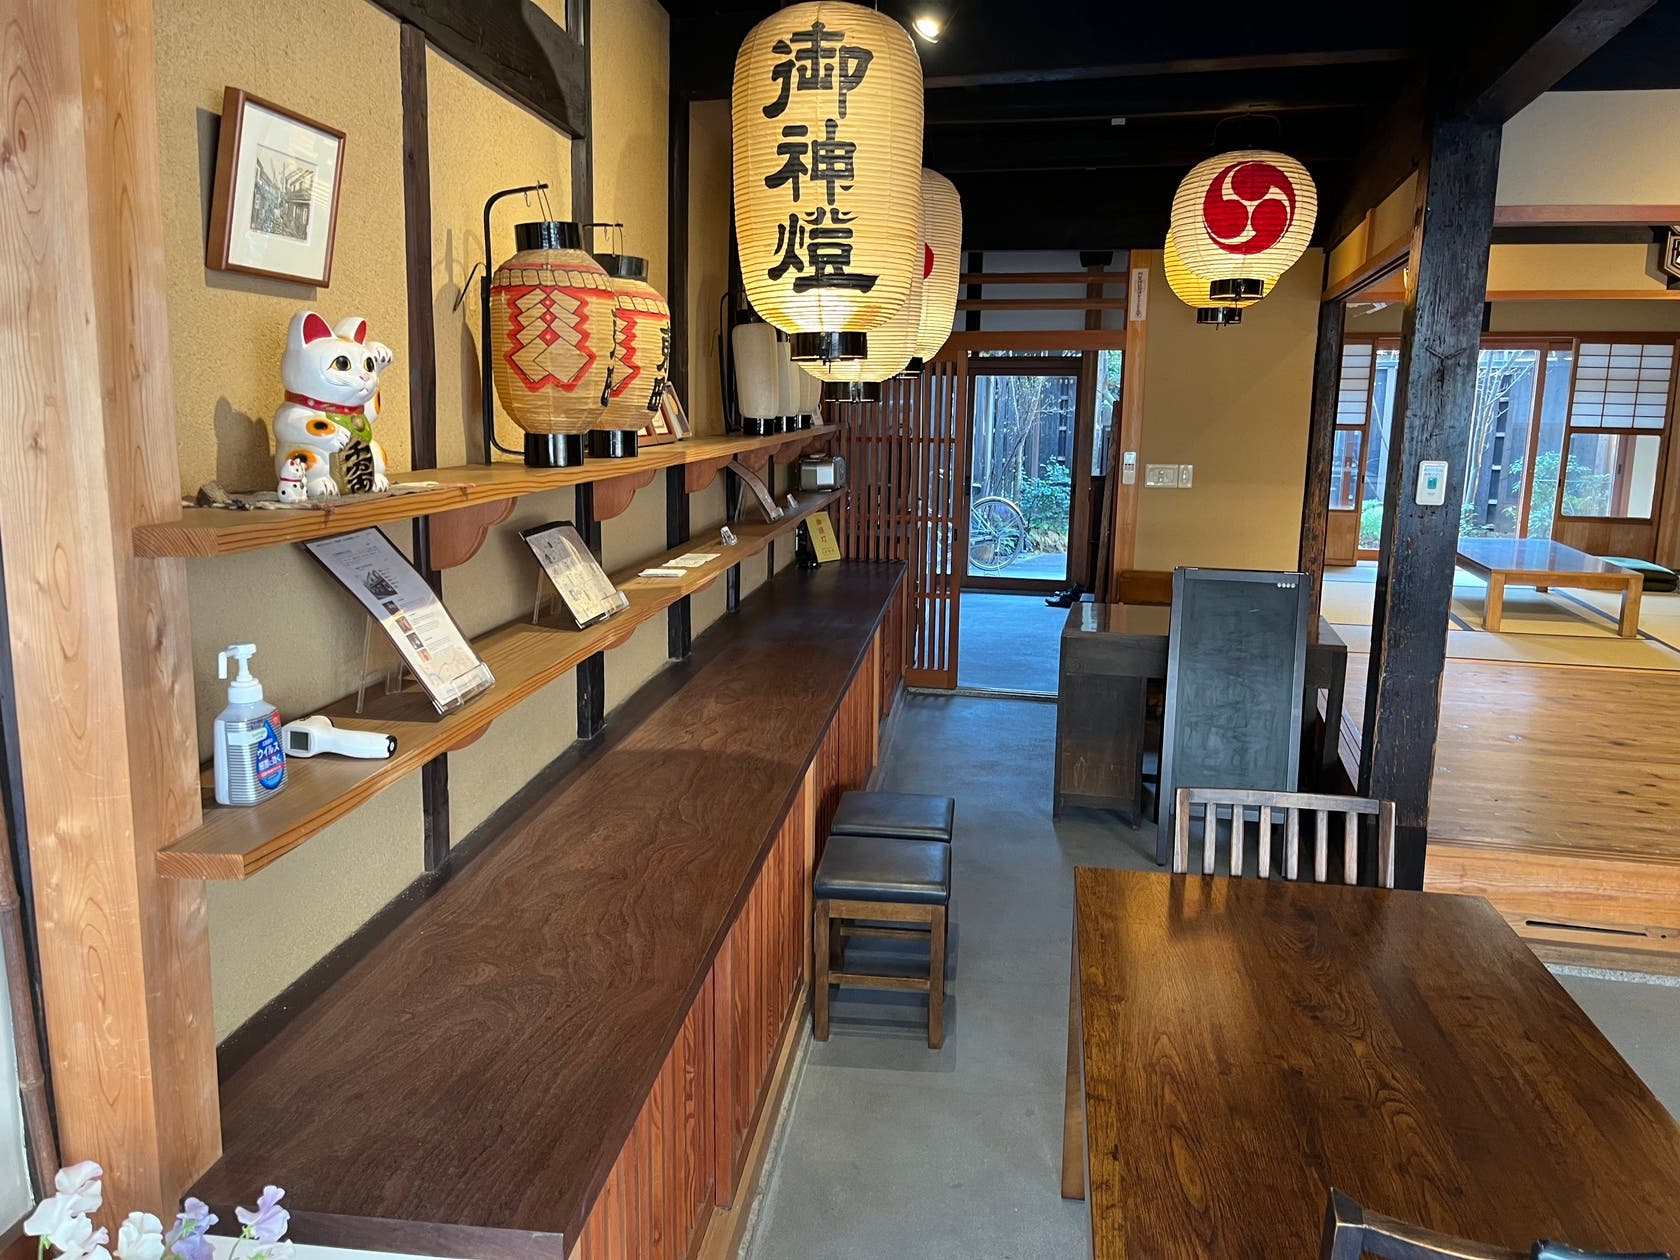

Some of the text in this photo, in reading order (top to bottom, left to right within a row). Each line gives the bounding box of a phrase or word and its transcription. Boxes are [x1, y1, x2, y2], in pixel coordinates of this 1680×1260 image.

[762, 22, 879, 293] 御神燈
[257, 742, 280, 760] ウイルス
